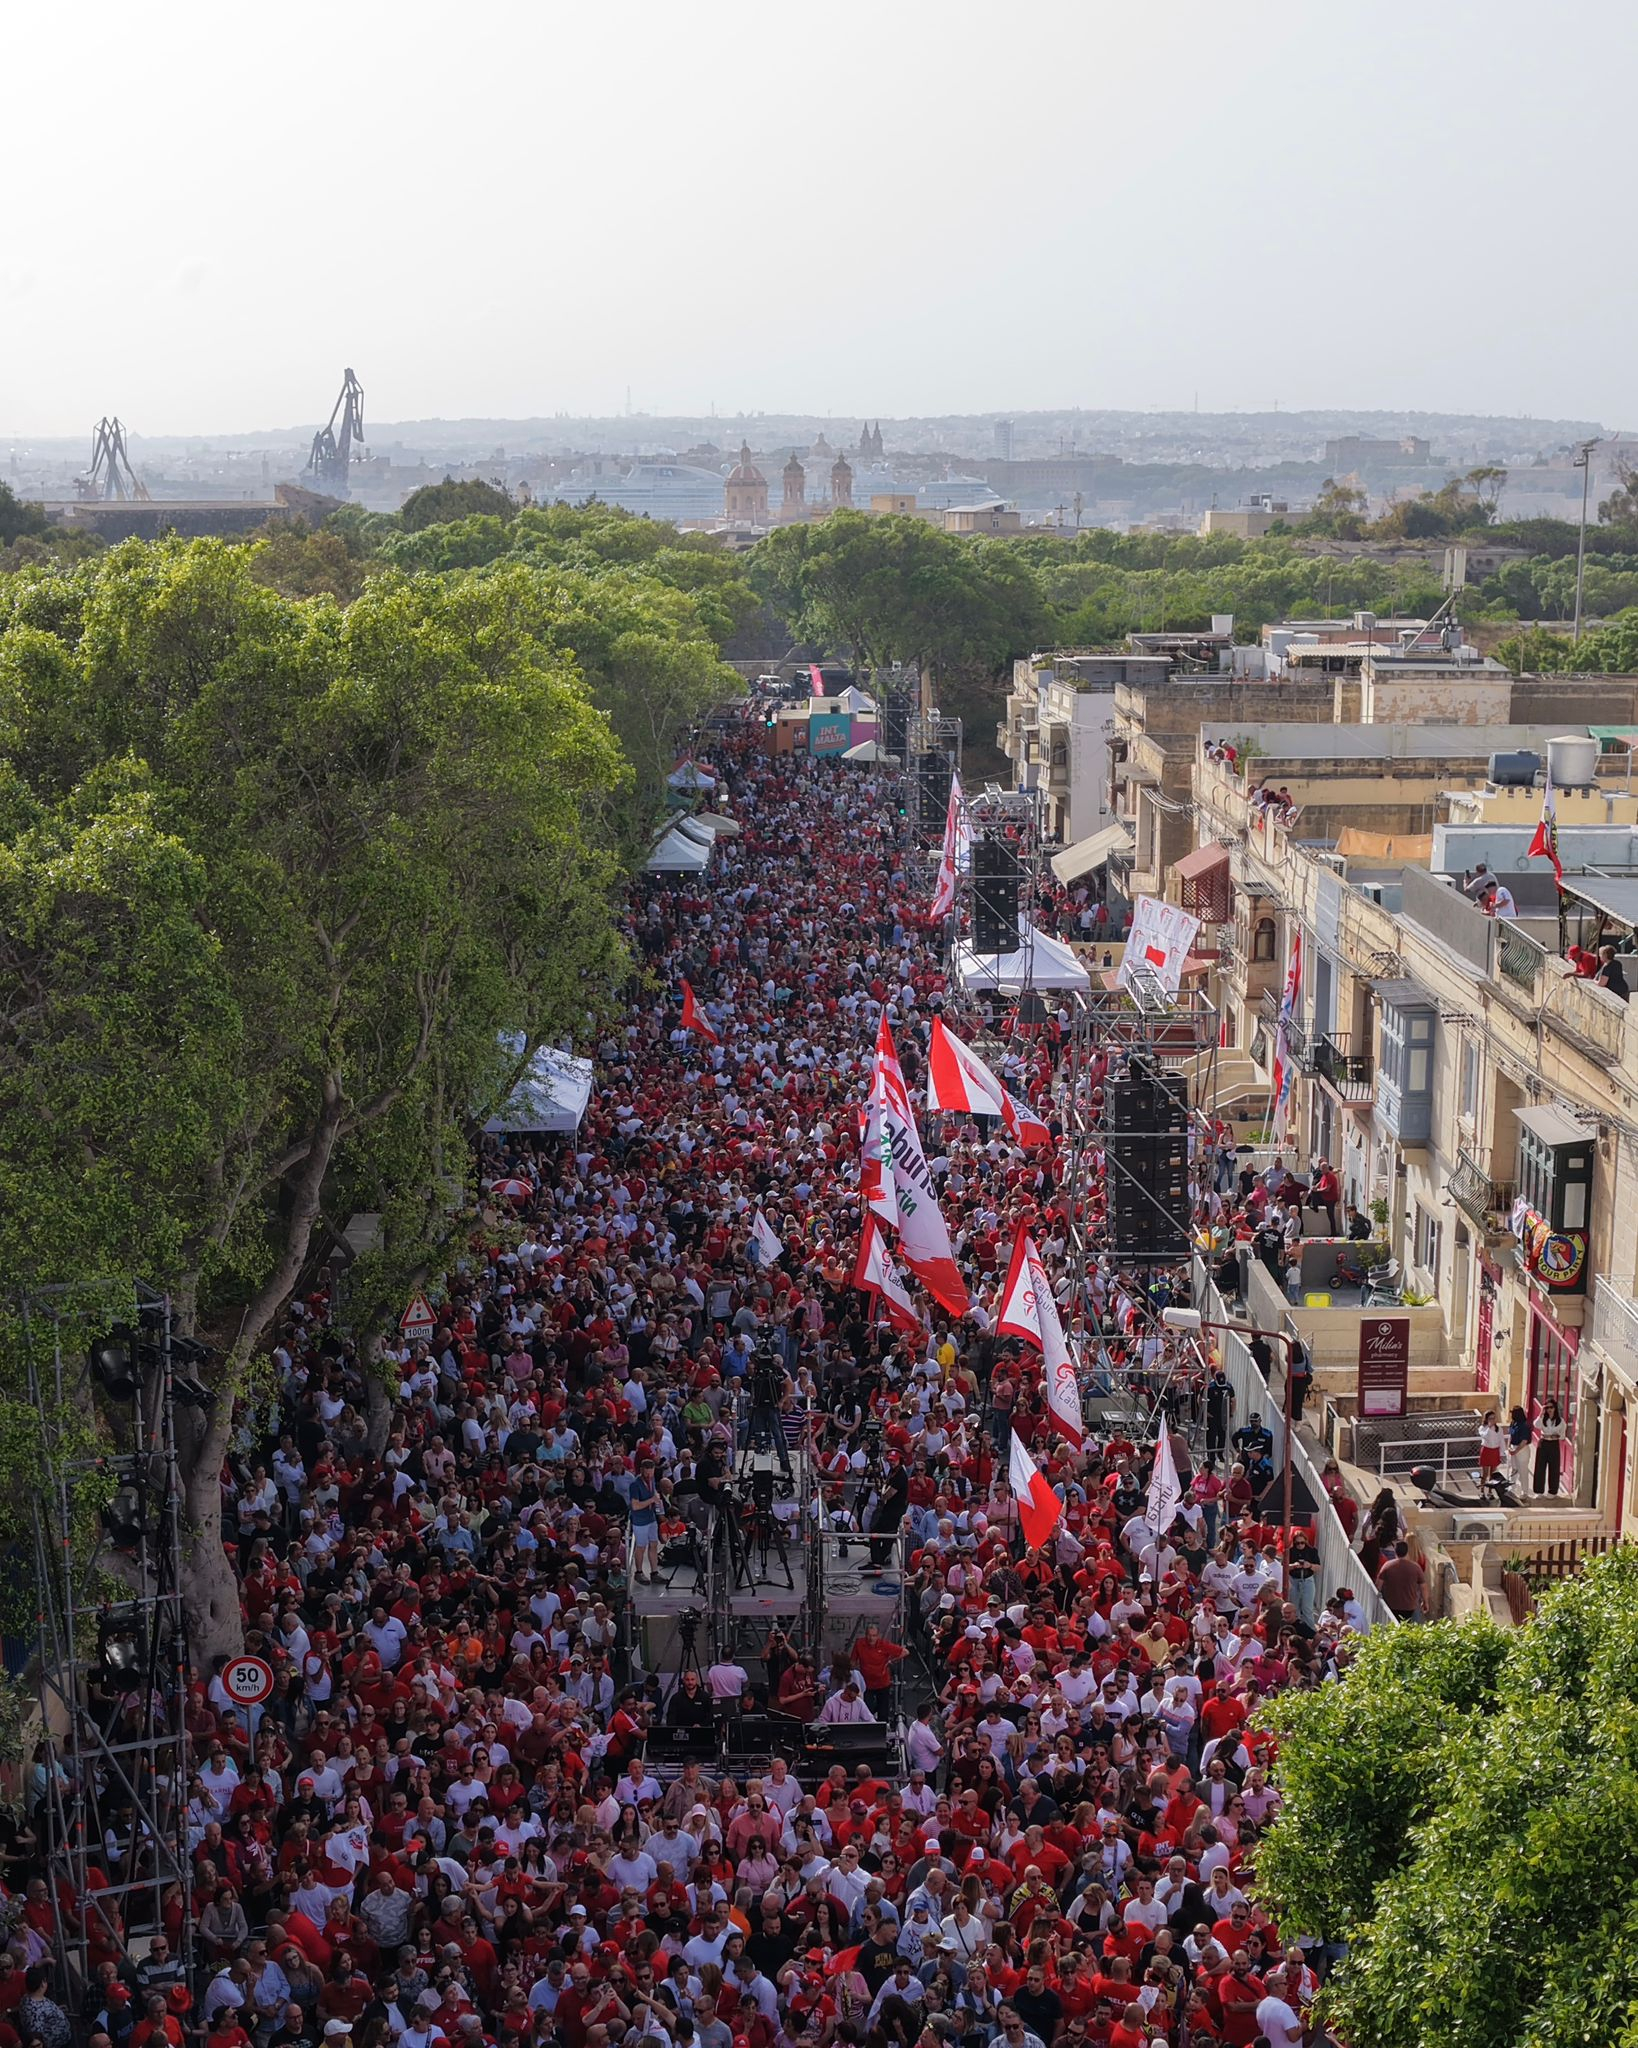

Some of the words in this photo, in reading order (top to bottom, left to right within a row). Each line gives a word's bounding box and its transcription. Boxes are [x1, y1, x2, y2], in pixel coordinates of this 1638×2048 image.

[820, 726, 838, 736] INT
[815, 733, 846, 745] MALTA
[236, 1667, 259, 1683] 50
[236, 1684, 260, 1692] km/h
